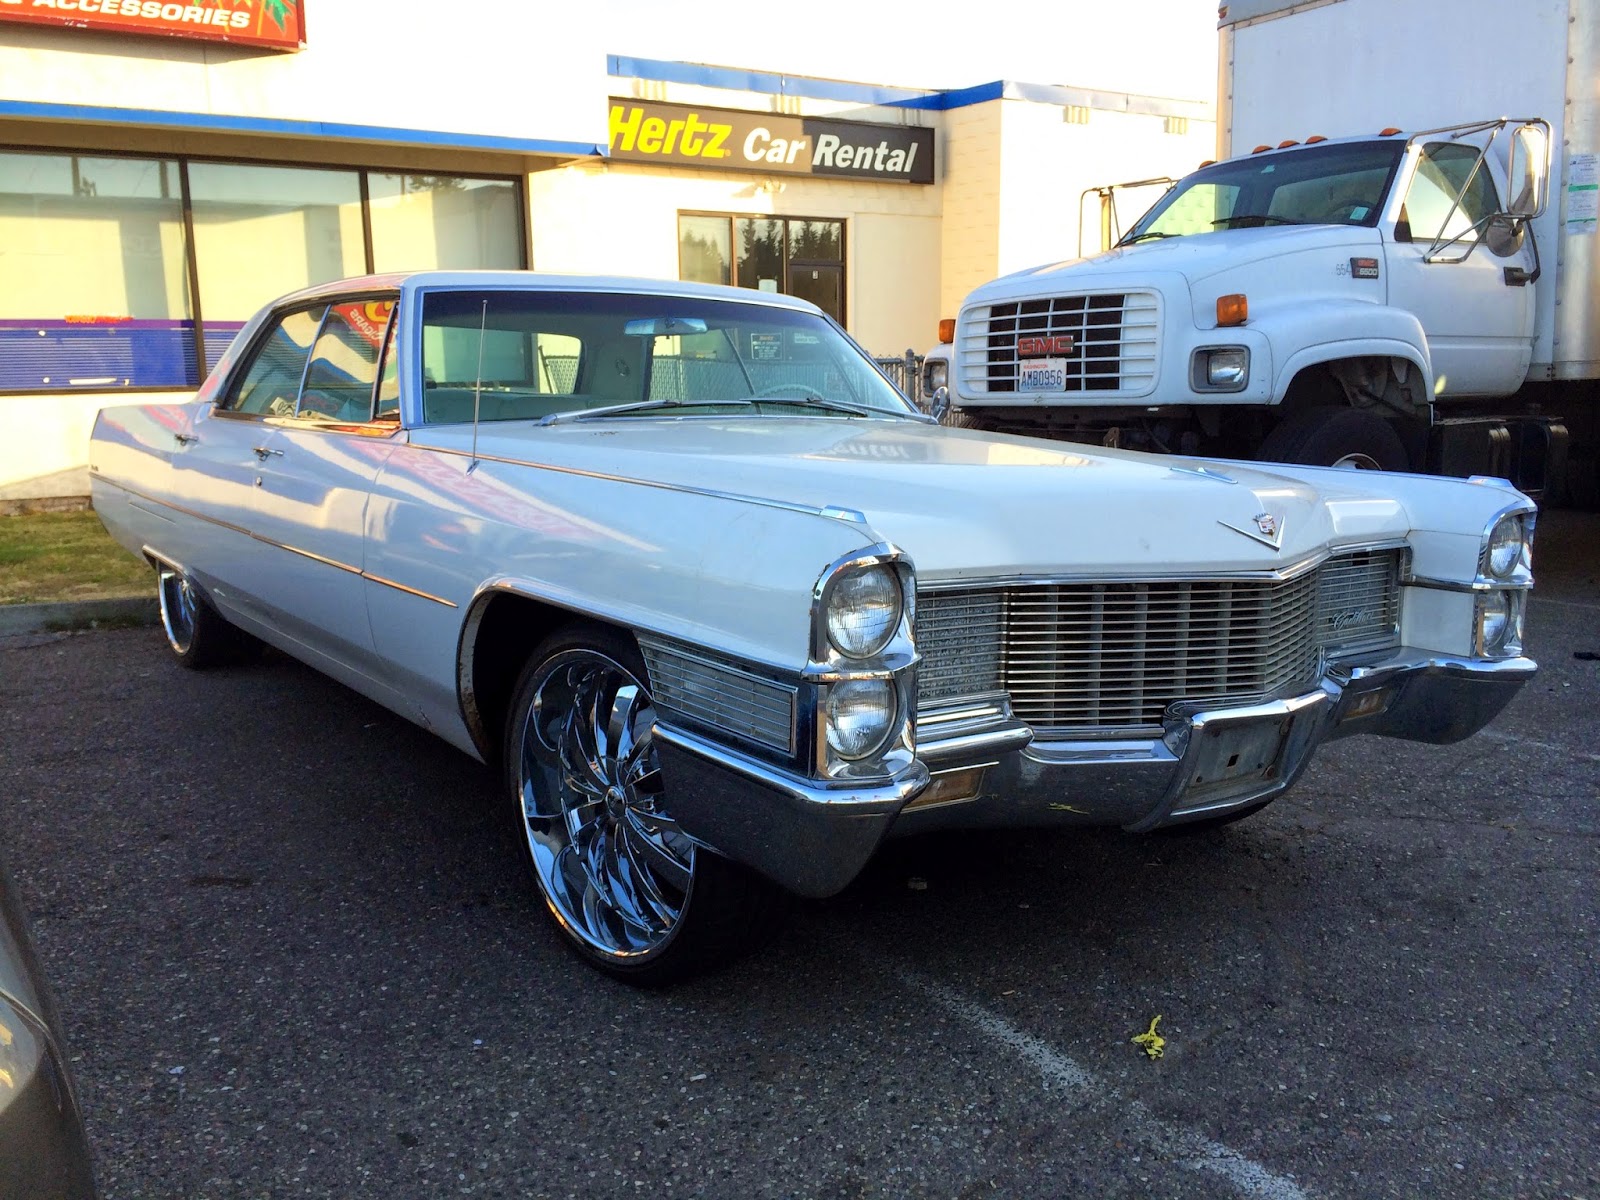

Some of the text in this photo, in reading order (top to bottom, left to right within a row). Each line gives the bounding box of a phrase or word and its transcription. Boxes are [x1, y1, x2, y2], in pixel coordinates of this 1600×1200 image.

[609, 105, 919, 173] Hertz Car Rental
[1019, 335, 1073, 355] GMC
[1021, 370, 1062, 386] AMB0956
